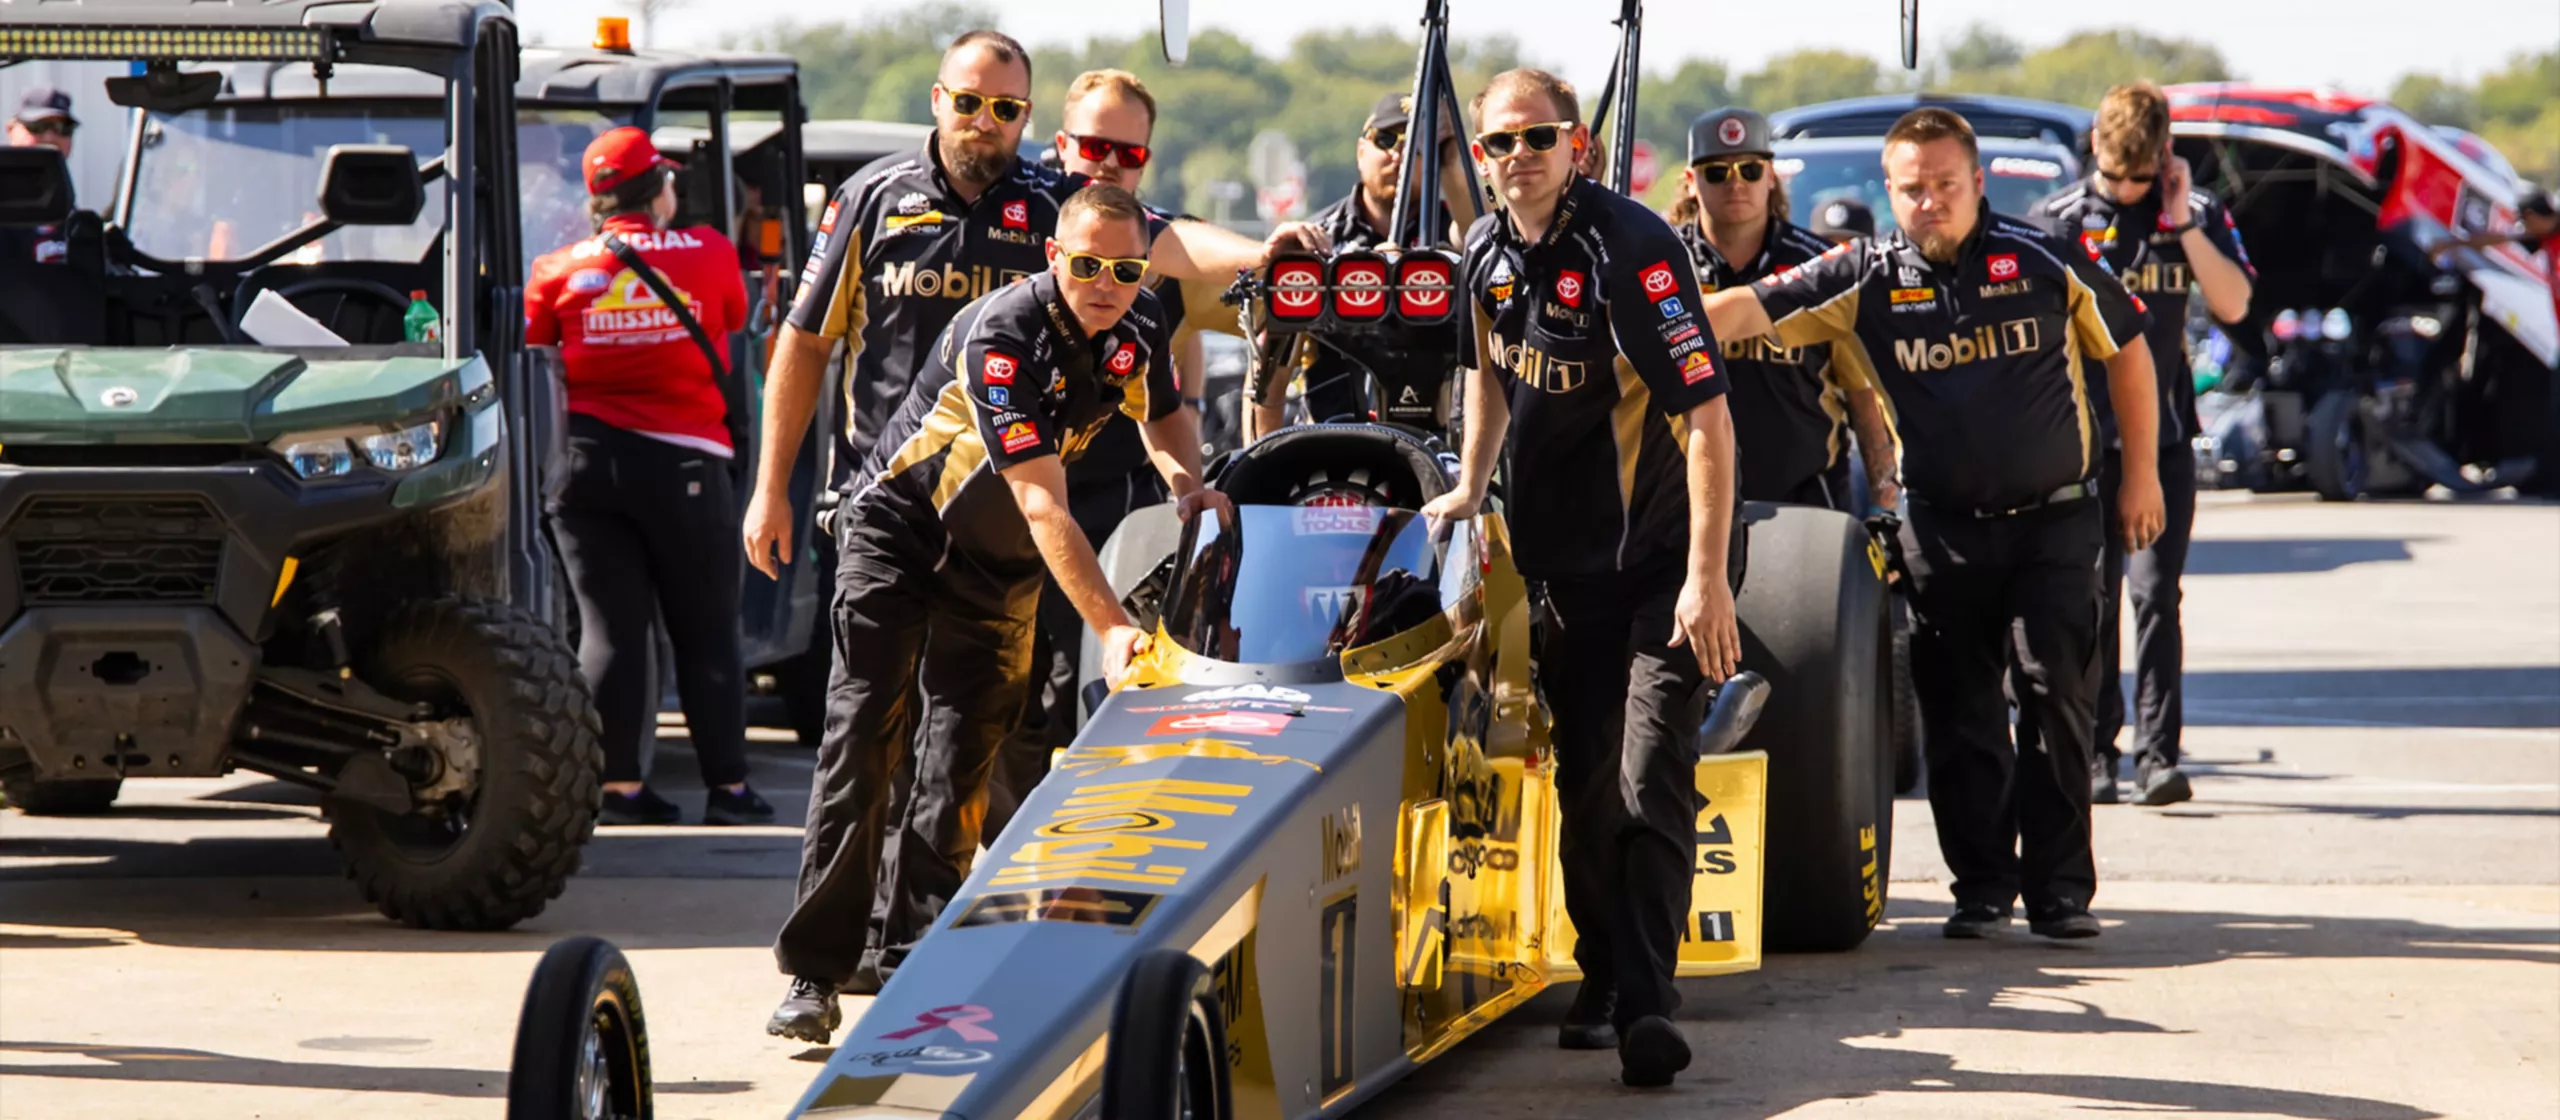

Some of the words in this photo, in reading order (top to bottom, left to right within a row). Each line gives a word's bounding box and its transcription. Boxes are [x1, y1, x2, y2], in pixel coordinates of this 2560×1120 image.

[988, 226, 1026, 244] Mobil
[882, 261, 992, 299] Mobil
[1979, 284, 2018, 298] Mobil
[587, 305, 698, 331] MISSIO
[1893, 325, 1998, 373] Mobil
[1301, 519, 1371, 533] TOOLS
[986, 777, 1254, 886] Mobil
[1321, 800, 1362, 886] Mobil
